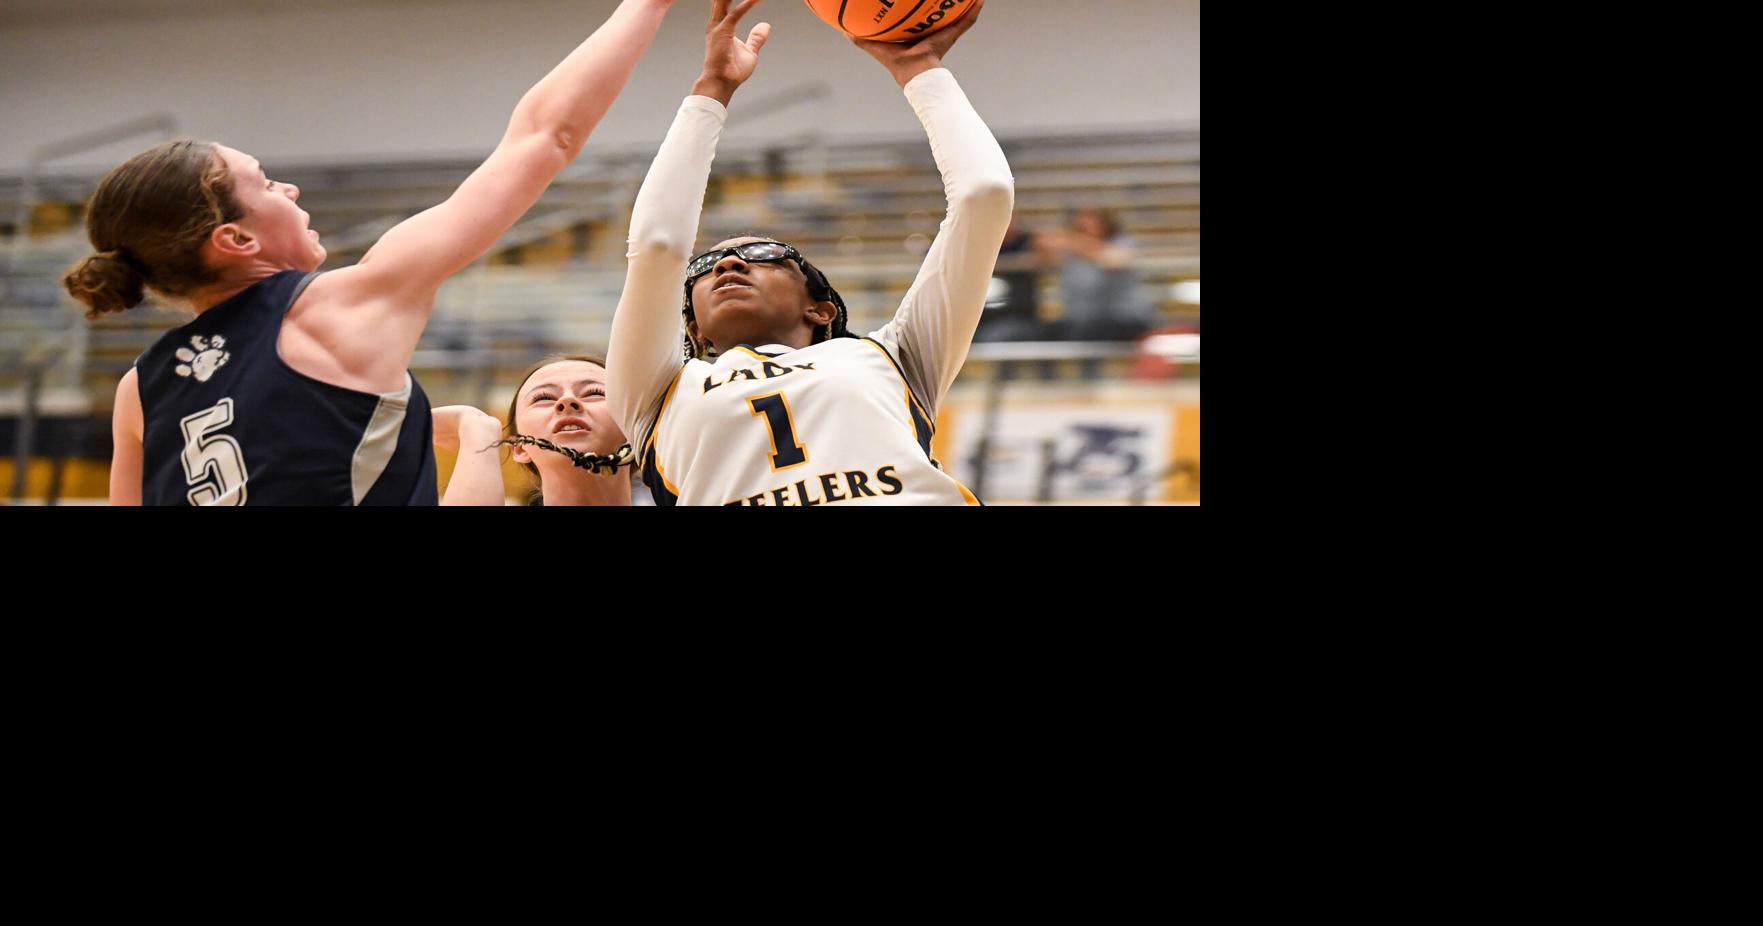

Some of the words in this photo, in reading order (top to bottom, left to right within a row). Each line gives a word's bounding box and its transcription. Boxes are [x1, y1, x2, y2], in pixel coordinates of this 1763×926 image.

[703, 361, 815, 394] LADY
[180, 397, 248, 506] 5
[746, 391, 809, 473] 1
[722, 465, 903, 506] EELERS
